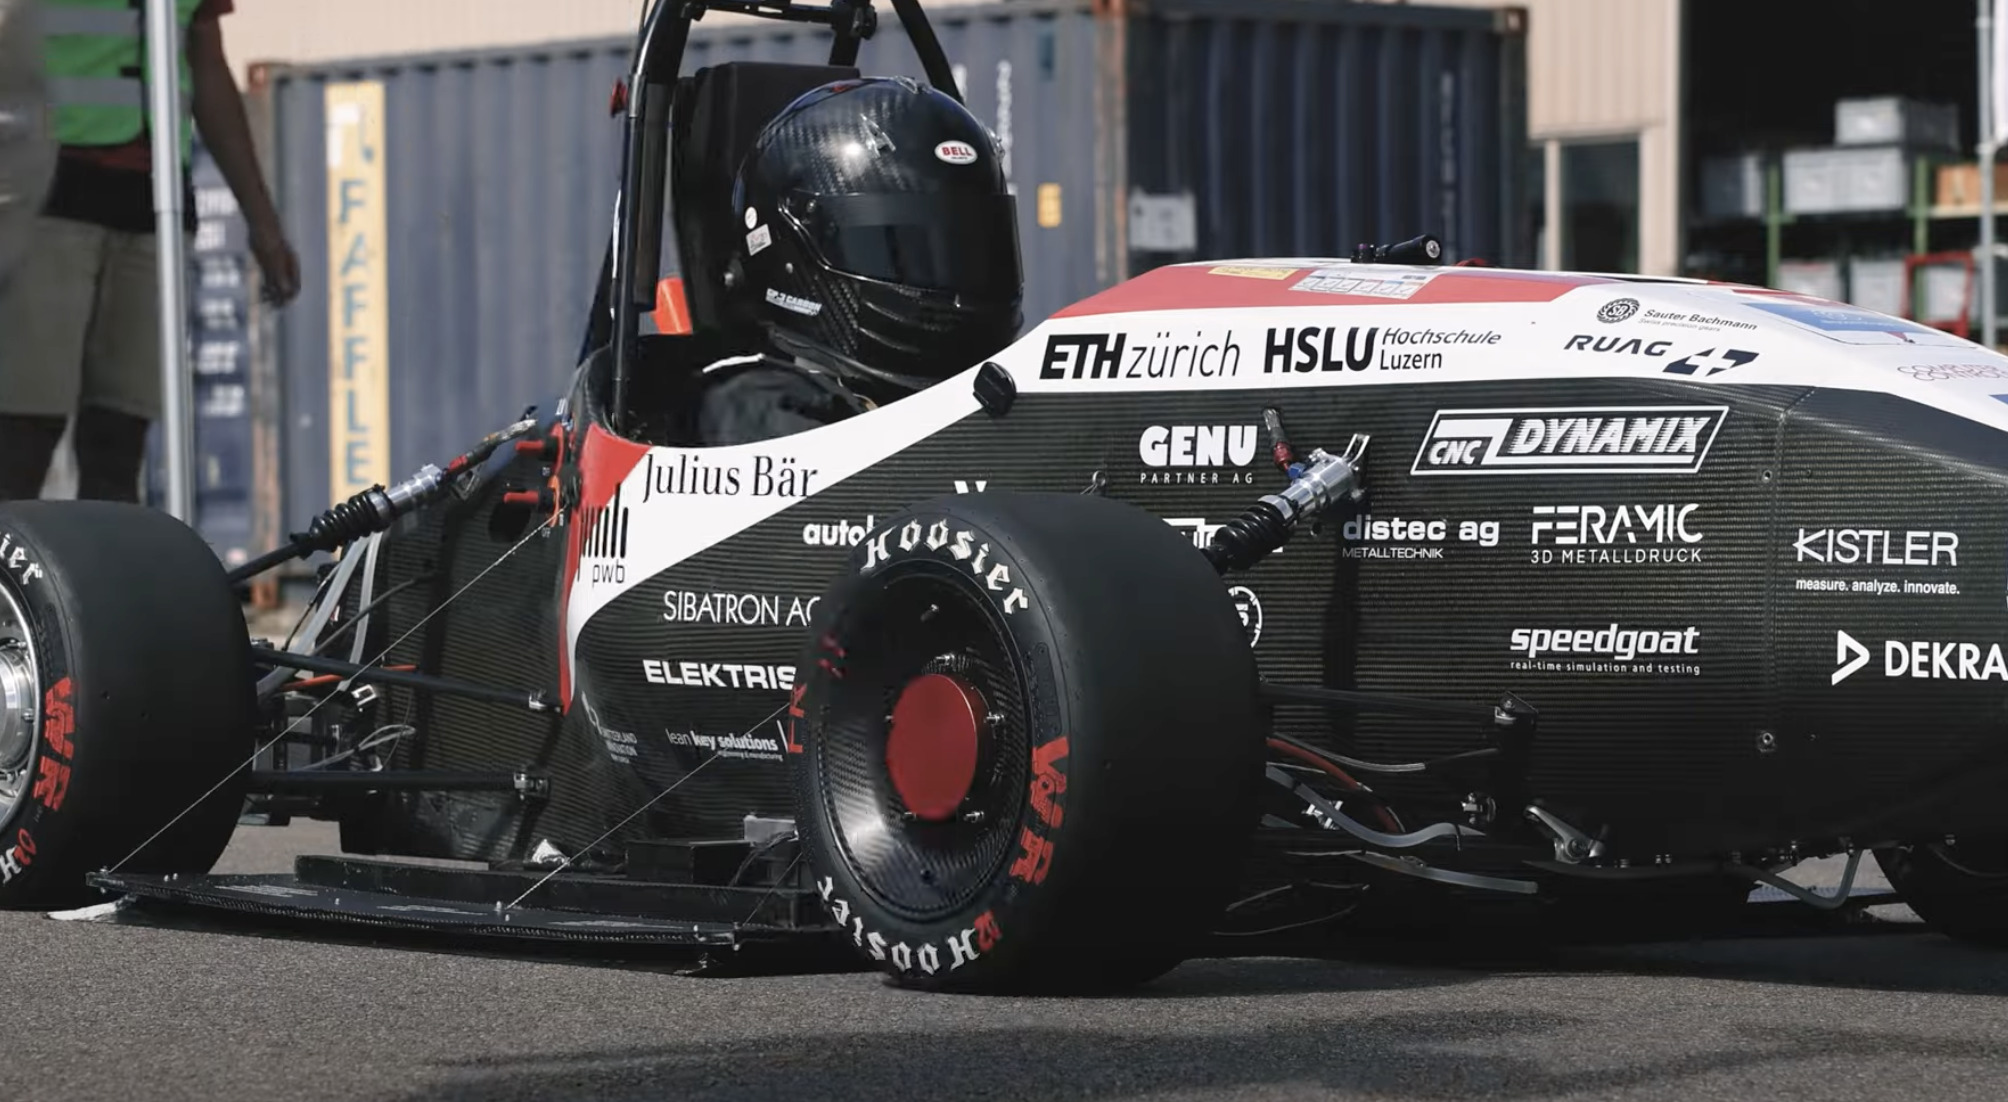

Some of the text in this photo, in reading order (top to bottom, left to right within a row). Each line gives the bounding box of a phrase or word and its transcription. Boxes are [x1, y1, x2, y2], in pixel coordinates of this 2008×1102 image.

[941, 146, 973, 157] BELL
[1643, 309, 1758, 331] Sauter Bachmann
[1264, 327, 1380, 374] HSLU
[1382, 327, 1502, 345] Hochschule
[1563, 334, 1674, 357] RUAG
[1379, 349, 1443, 371] Luzern
[1139, 425, 1258, 467] GENU
[1427, 416, 1712, 465] CNC DYNAMIX
[642, 453, 819, 504] Julius Bär
[1140, 472, 1254, 485] PARTNER AG
[1343, 513, 1500, 547] distec ag
[1531, 503, 1704, 545] FERAMIC
[1342, 547, 1444, 559] METALLTECHNIK
[1531, 548, 1702, 564] 3D METALLDRUCK
[1792, 528, 1959, 567] KISTLER
[592, 560, 626, 588] pwb
[860, 518, 1029, 615] Hoosier
[1796, 578, 1961, 596] measure. analyze. innovate.
[663, 590, 779, 625] SIBATRON
[1510, 623, 1701, 661] speedgoat
[1510, 660, 1701, 676] real-time simulation and testing
[1885, 639, 2008, 682] DEKRA
[665, 728, 780, 752] lean key solutions
[817, 876, 981, 986] Hoosier
